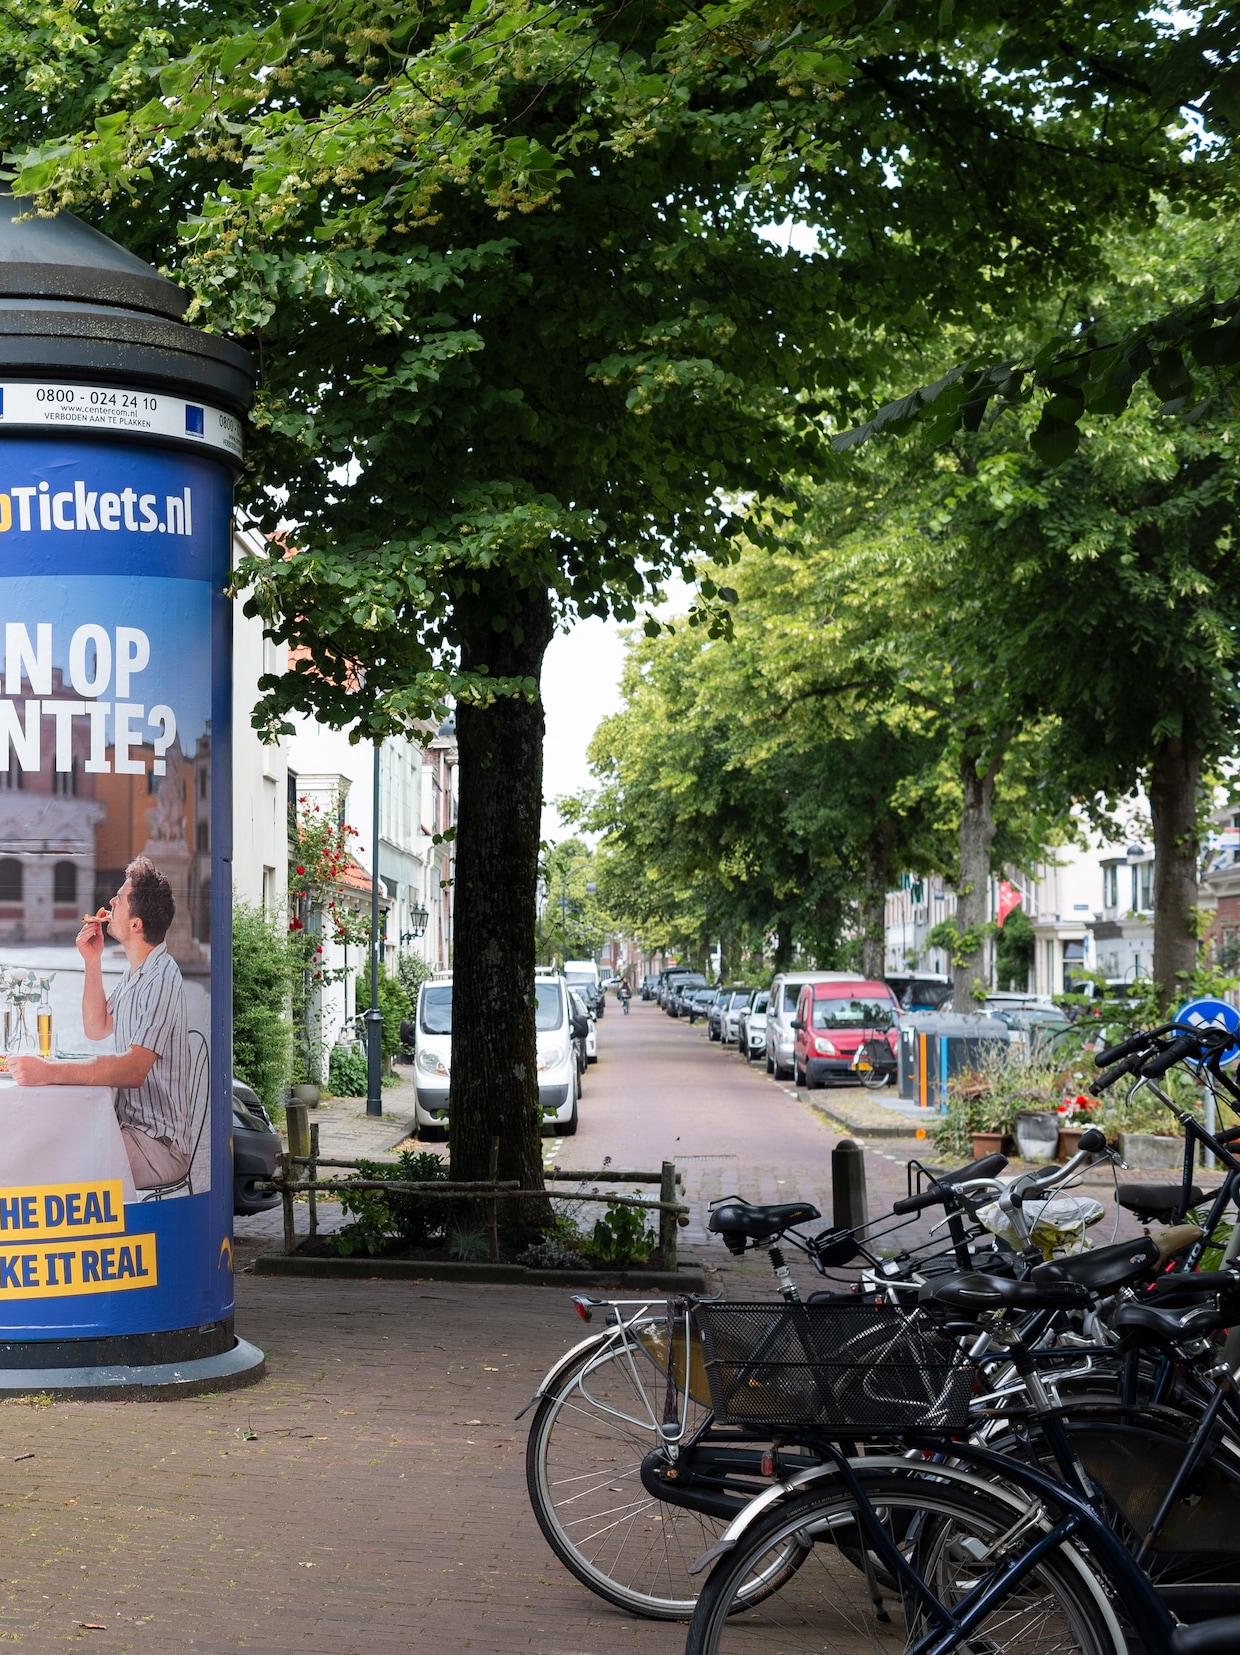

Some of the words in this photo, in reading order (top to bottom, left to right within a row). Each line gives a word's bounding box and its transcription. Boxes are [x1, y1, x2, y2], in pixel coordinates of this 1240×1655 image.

[36, 388, 74, 403] 0800
[90, 391, 117, 406] 024
[122, 394, 138, 408] 24
[143, 397, 157, 411] 10
[60, 405, 138, 418] www.centercom.nl
[44, 412, 88, 422] VERBODEN
[89, 415, 105, 423] AAN
[108, 416, 117, 424] TE
[119, 417, 151, 428] PLAKKEN
[68, 623, 151, 698] OP
[44, 1190, 118, 1228] DEAL
[44, 1251, 76, 1286] IT
[81, 1244, 149, 1283] REAL
